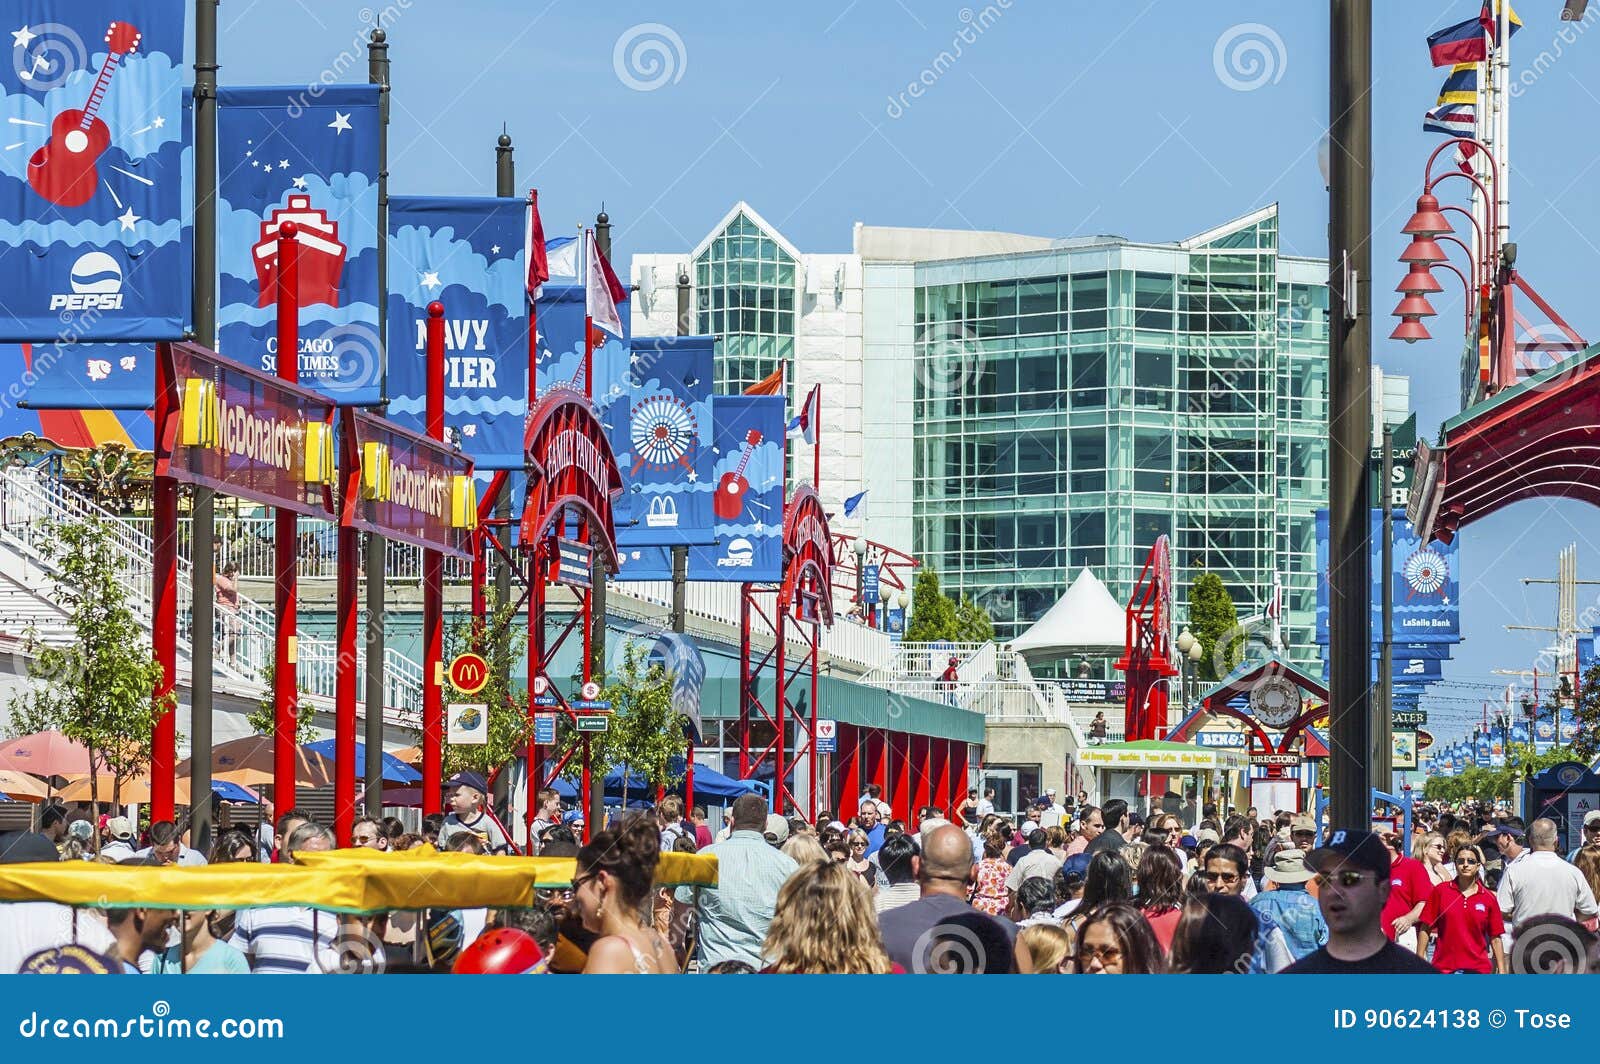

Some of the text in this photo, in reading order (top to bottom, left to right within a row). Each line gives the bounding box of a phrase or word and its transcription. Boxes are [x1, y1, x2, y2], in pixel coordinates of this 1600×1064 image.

[49, 294, 123, 310] PEPSI
[444, 357, 497, 388] IER
[547, 429, 609, 503] FAMILY PAVILION
[716, 558, 753, 567] PEPSI
[1432, 618, 1451, 627] Bank
[1249, 755, 1298, 764] DIRECTORY
